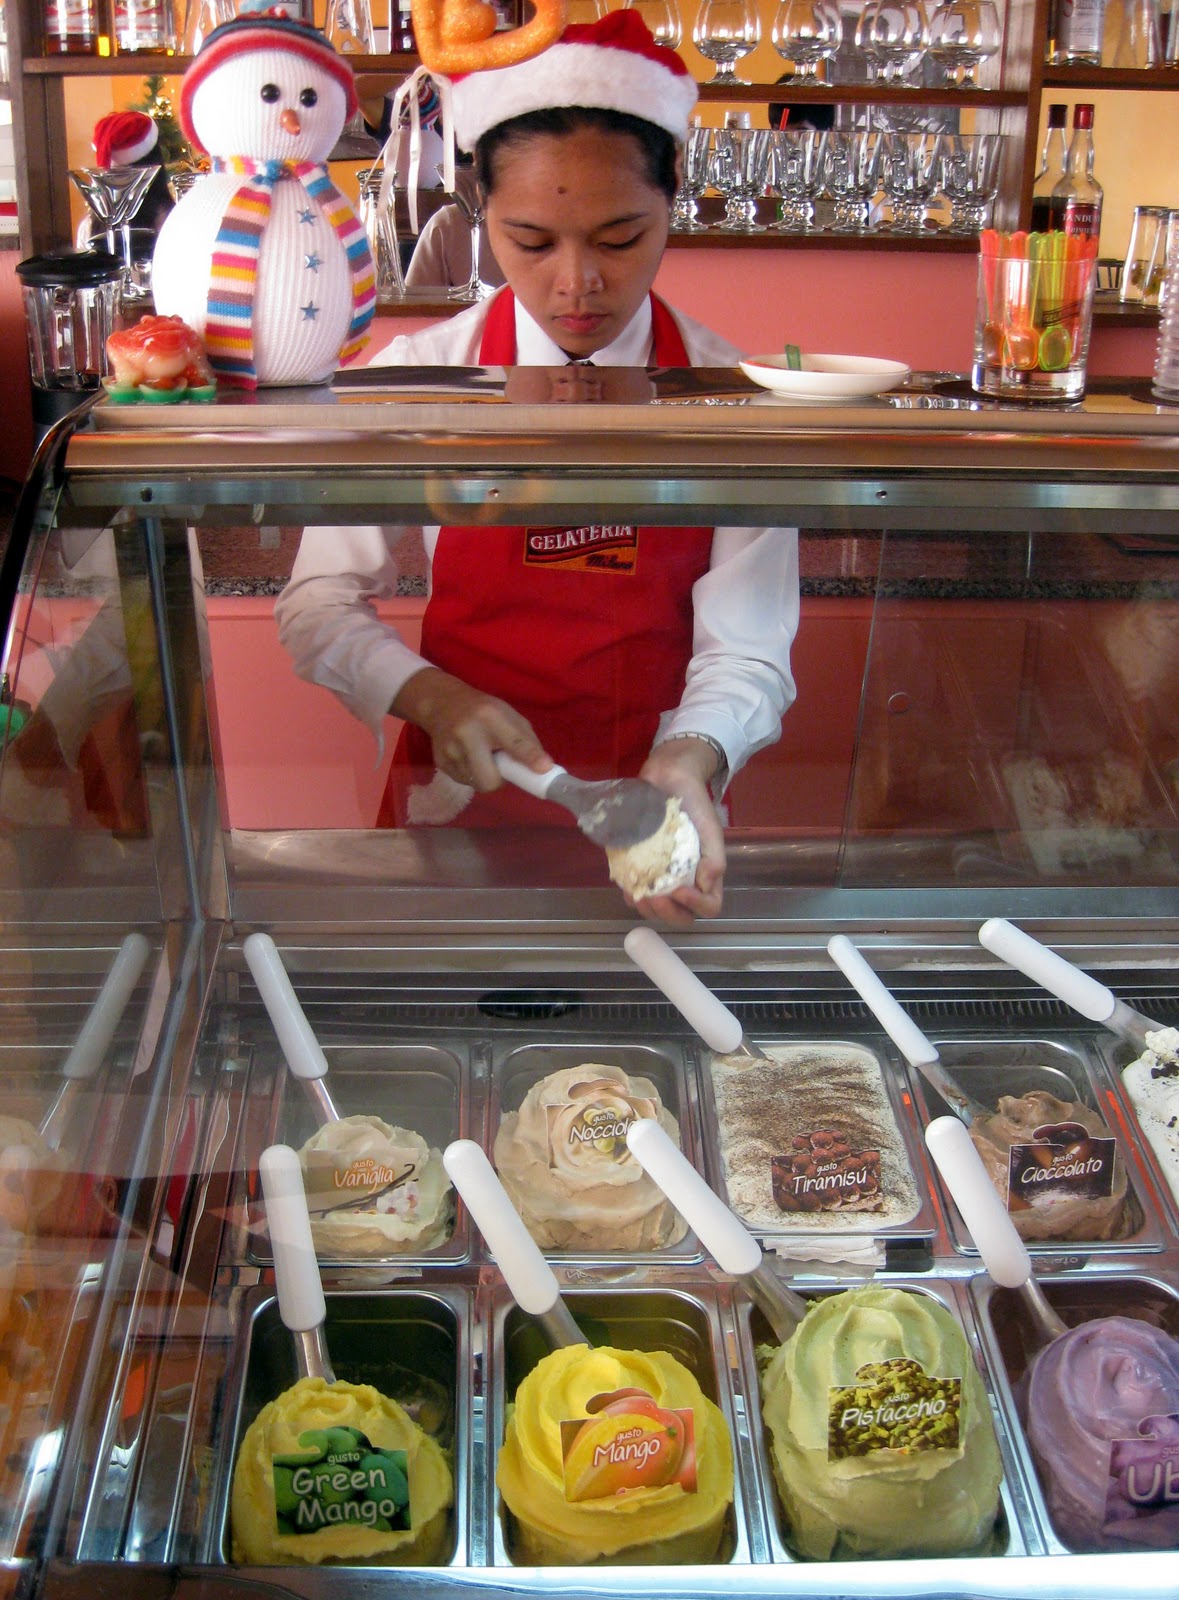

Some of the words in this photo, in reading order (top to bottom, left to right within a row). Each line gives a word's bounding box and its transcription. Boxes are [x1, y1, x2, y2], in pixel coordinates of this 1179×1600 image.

[530, 525, 633, 550] GELATERIA
[592, 1112, 615, 1126] gusto
[352, 1159, 375, 1172] gusto
[816, 1162, 838, 1176] gusto
[1021, 1157, 1103, 1184] Cioccolato
[1052, 1153, 1073, 1167] gusto
[334, 1166, 394, 1195] Vaniglia
[884, 1392, 910, 1406] gusto
[840, 1397, 947, 1429] Pistacchio
[616, 1428, 642, 1446] gusto
[327, 1452, 360, 1466] gusto
[593, 1438, 661, 1470] Mango
[292, 1468, 387, 1496] Green
[297, 1498, 395, 1526] Mango
